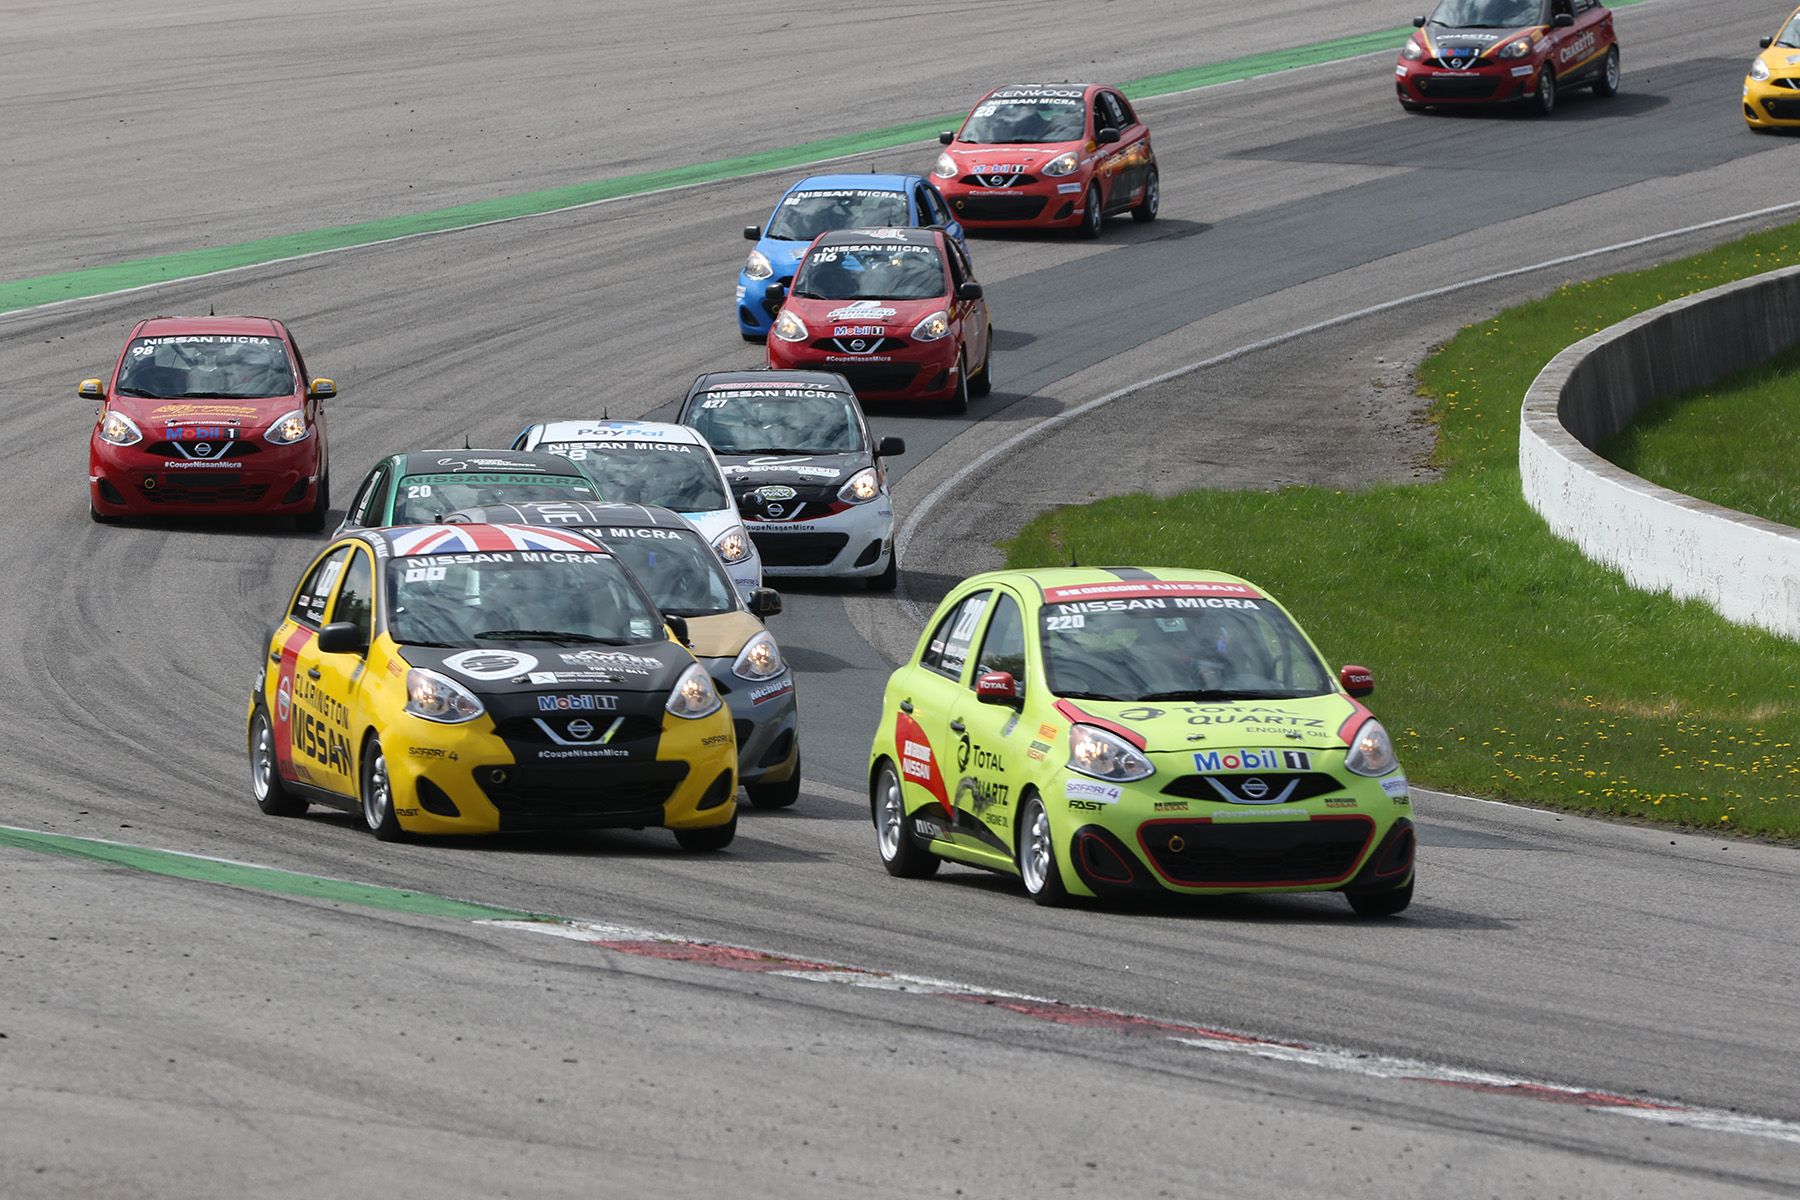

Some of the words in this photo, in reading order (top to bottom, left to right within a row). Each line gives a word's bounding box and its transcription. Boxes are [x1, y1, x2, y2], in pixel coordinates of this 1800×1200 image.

[992, 88, 1083, 98] KENWOOD
[987, 98, 1038, 106] NISSAN
[1039, 97, 1076, 106] MICRA
[797, 190, 853, 199] NISSAN
[856, 190, 898, 199] MICRA
[822, 245, 883, 254] NISSAN
[886, 245, 930, 254] MICRA
[813, 252, 838, 263] 116
[834, 325, 871, 336] Mobil
[144, 336, 214, 346] NISSAN
[219, 336, 270, 345] MICRA
[132, 345, 154, 357] 98
[706, 390, 779, 399] NISSAN
[785, 389, 838, 400] MICRA
[701, 399, 728, 409] 427
[165, 426, 220, 440] Mobil
[577, 428, 665, 438] PayPal
[548, 442, 627, 452] NISSAN
[633, 441, 691, 453] MICRA
[164, 461, 242, 469] #CoupeNissanMicra
[405, 475, 494, 486] NISSAN
[508, 475, 587, 487] MICRA
[407, 485, 432, 499] 20
[742, 524, 815, 533] oupeNissanMicra
[609, 528, 683, 541] MICRA
[406, 553, 514, 569] NISSAN
[522, 552, 598, 565] MICRA
[1151, 584, 1247, 593] NISSAN
[1058, 598, 1167, 615] NISSAN
[1176, 598, 1261, 611] MICRA
[1046, 614, 1086, 631] 220
[1349, 674, 1374, 684] TOTAL
[979, 680, 1009, 690] TOTAL
[294, 673, 350, 730] CLARINGTON
[536, 695, 594, 711] Mobil
[1173, 706, 1299, 714] TOTAL
[1187, 714, 1325, 728] QUARTZ
[1246, 726, 1300, 736] ENGINE
[1306, 730, 1331, 738] OIL
[292, 703, 353, 777] NISSAN
[537, 748, 629, 759] #CoupeNissanMicra
[973, 745, 1005, 772] TOTAL
[1193, 749, 1279, 773] Mobil
[1283, 751, 1312, 771] 1
[902, 757, 930, 780] NISSAN
[1066, 782, 1105, 795] SAFARI
[1106, 787, 1120, 800] 4
[1069, 800, 1107, 811] FAST
[396, 808, 420, 817] FAST
